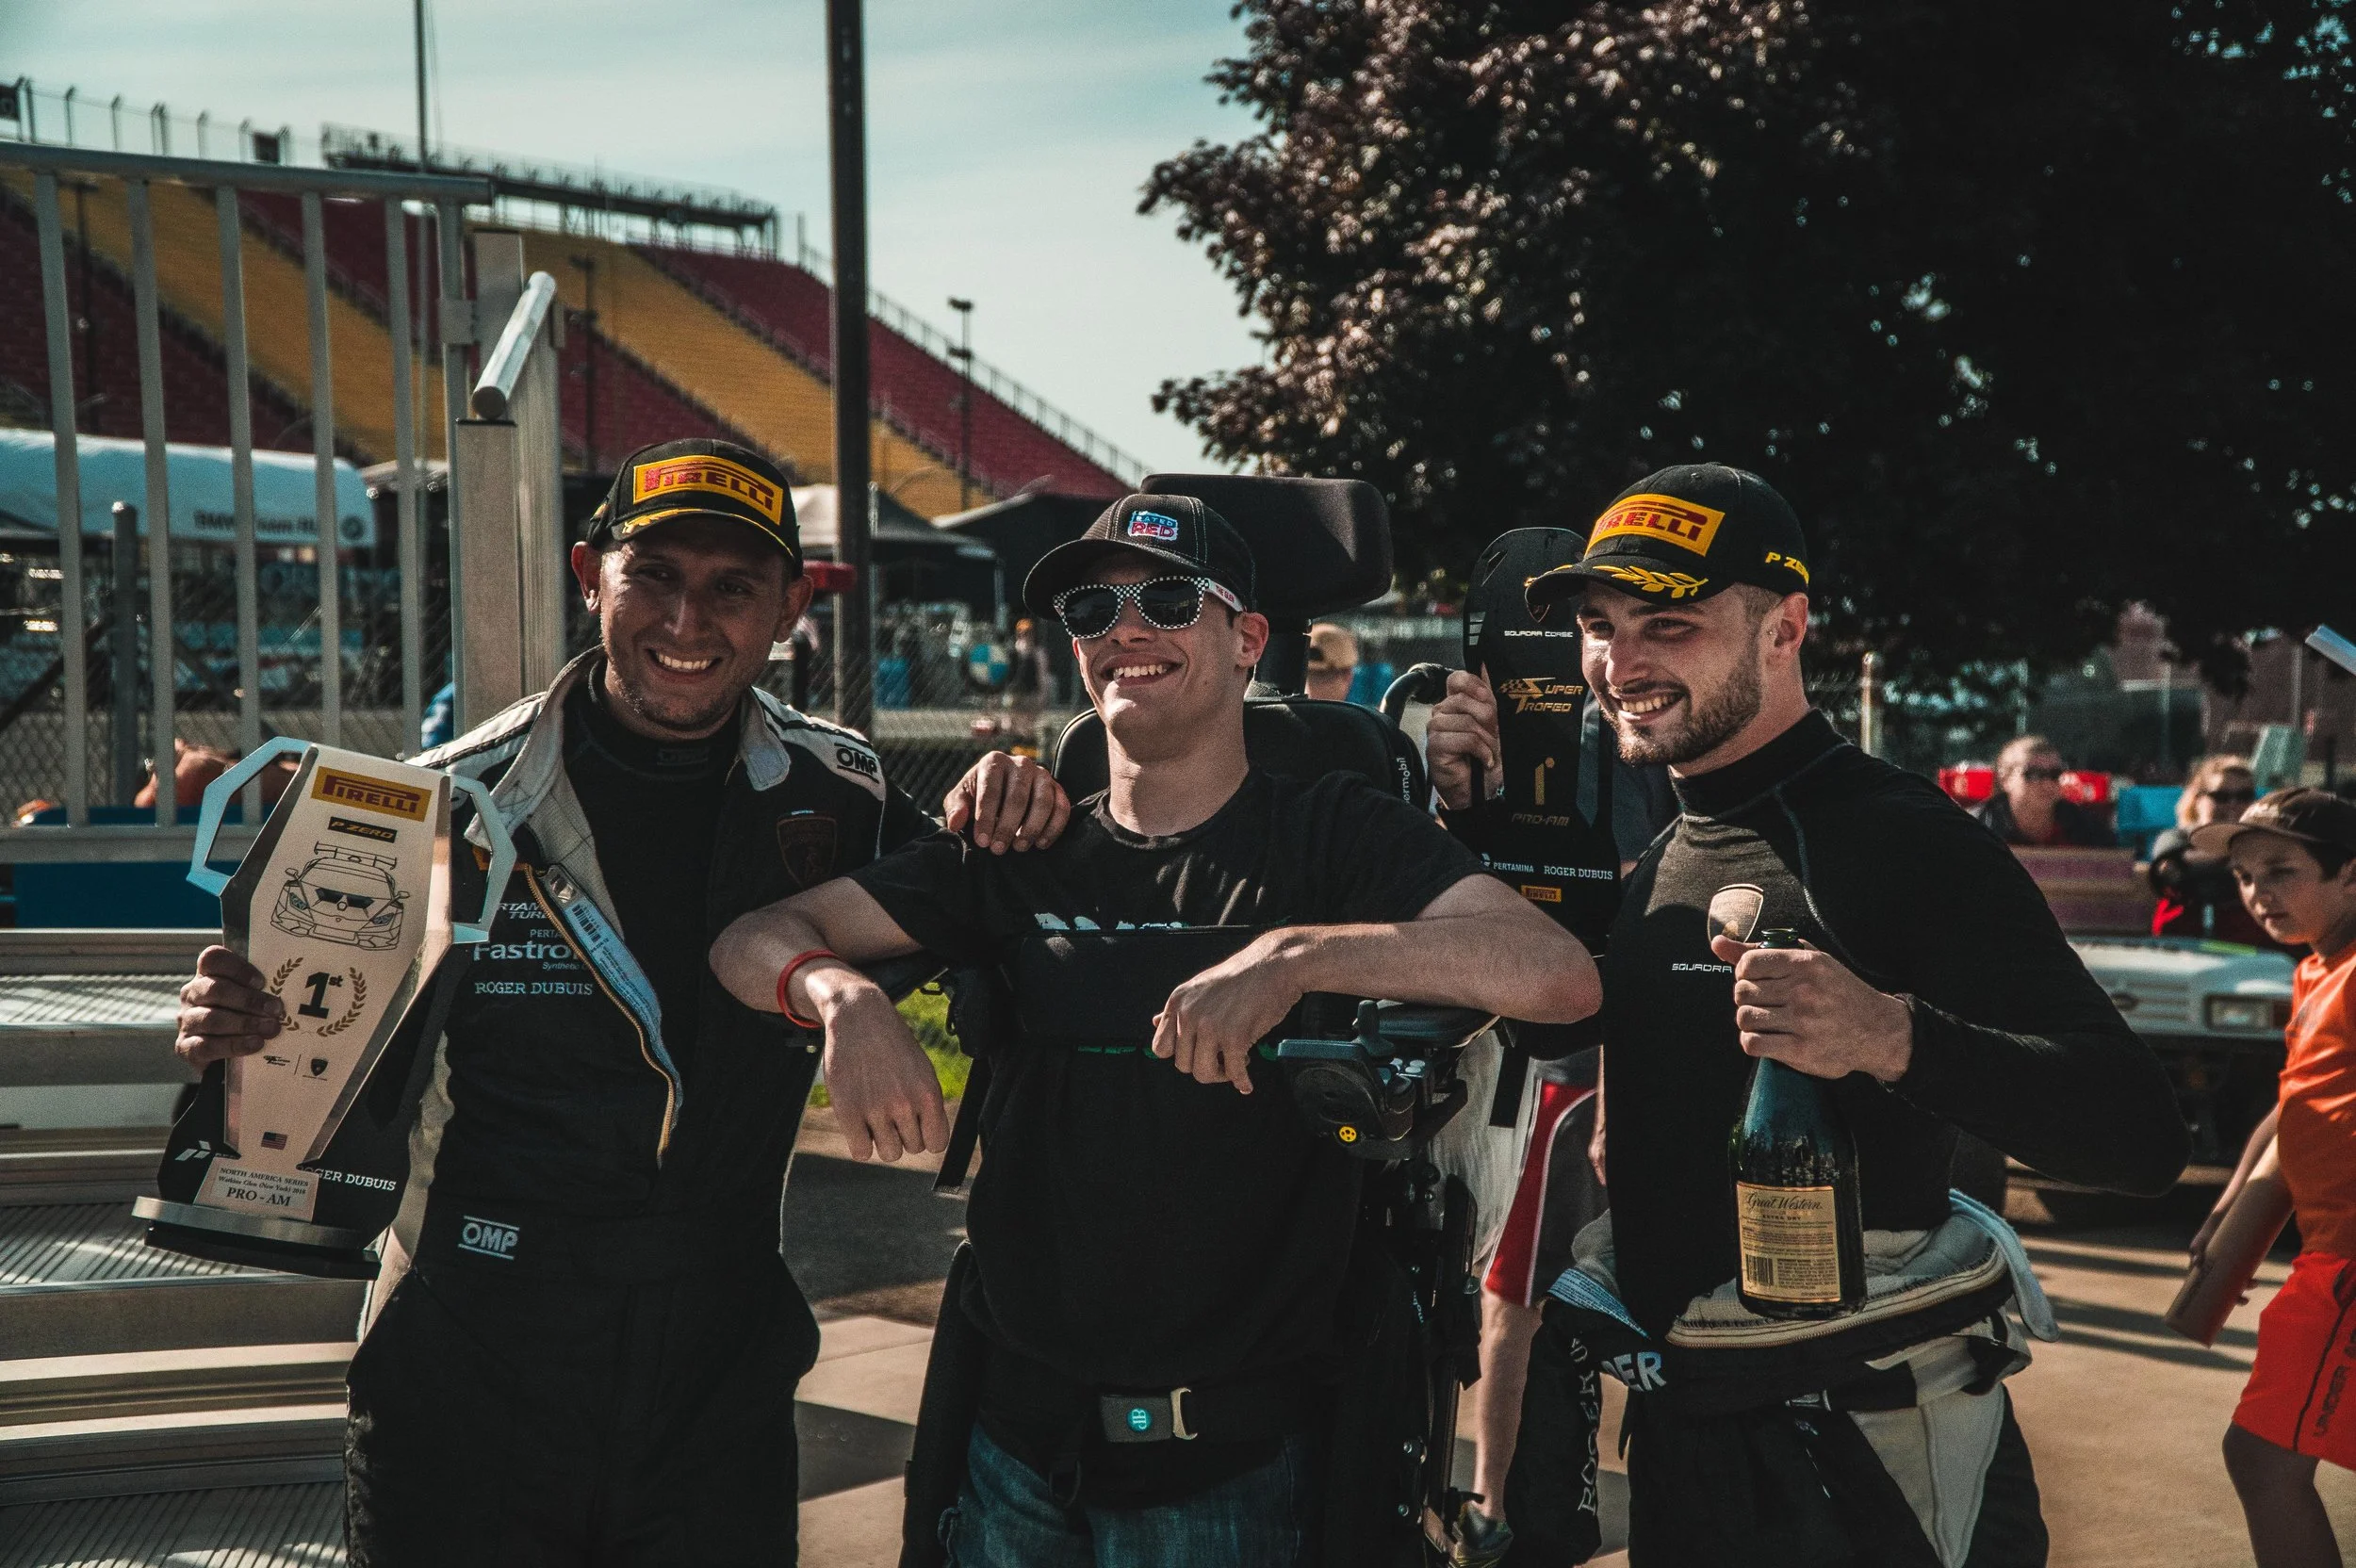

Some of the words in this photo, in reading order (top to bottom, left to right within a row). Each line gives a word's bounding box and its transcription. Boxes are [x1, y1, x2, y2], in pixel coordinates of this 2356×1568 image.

[644, 460, 775, 511] PIRELLI
[1131, 522, 1174, 537] RED
[1136, 515, 1173, 527] RATED
[1764, 551, 1781, 564] P
[836, 747, 877, 776] OMP
[322, 775, 420, 813] PIRELLI
[346, 825, 395, 839] ZERO
[1493, 861, 1534, 874] PERTAMINA
[1544, 865, 1577, 877] ROGER
[1578, 868, 1613, 881] DUBUIS
[542, 961, 581, 972] Synthetic
[1671, 963, 1732, 973] SQUADRA
[298, 972, 343, 1019] 1st
[474, 981, 526, 995] ROGER
[530, 981, 595, 996] DUBUIS
[220, 1167, 247, 1177] NORTH
[248, 1171, 282, 1184] AMERICA
[284, 1177, 309, 1187] SERIES
[345, 1173, 397, 1191] DUBUIS
[226, 1186, 258, 1201] PRO
[267, 1193, 292, 1207] AM
[1745, 1191, 1777, 1213] Great
[1777, 1195, 1824, 1210] Western
[461, 1220, 519, 1253] OMP
